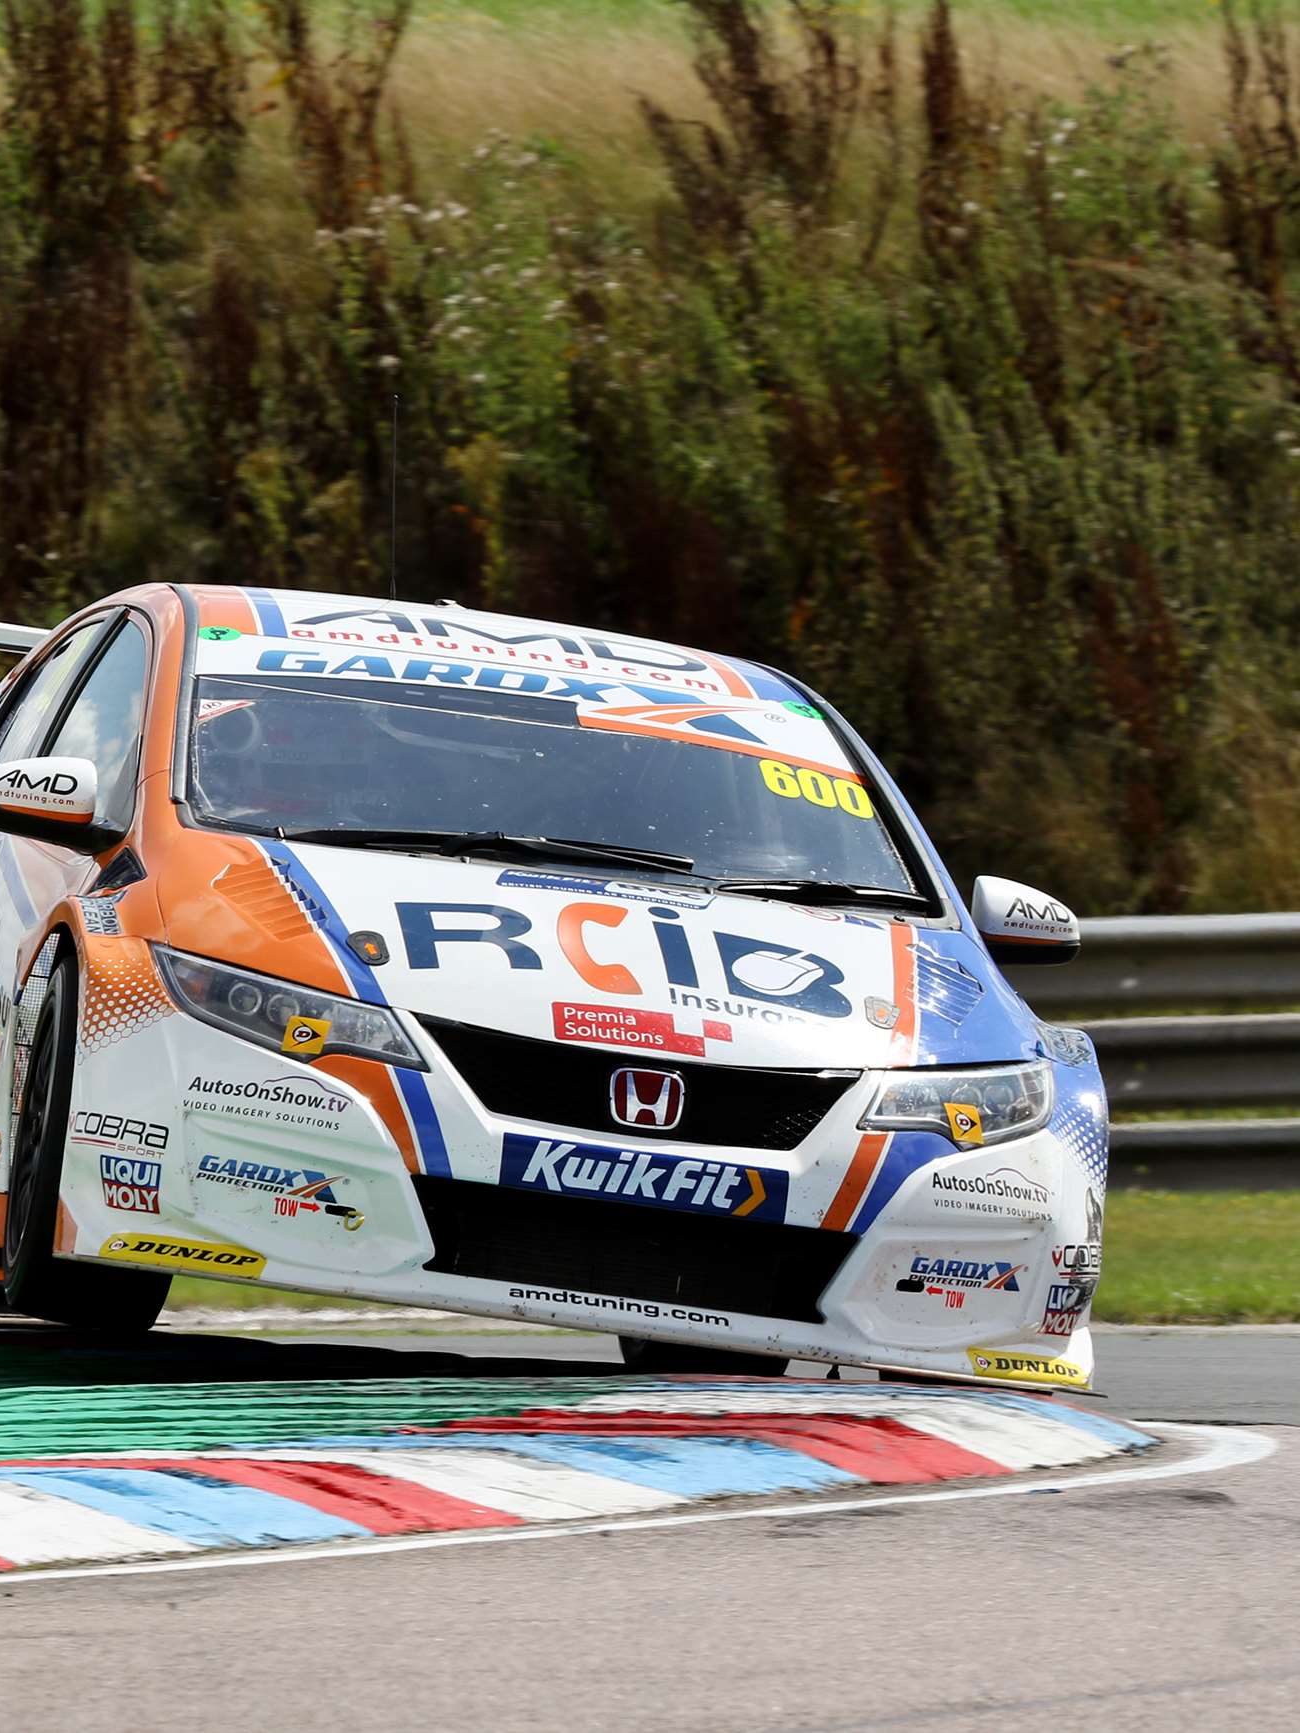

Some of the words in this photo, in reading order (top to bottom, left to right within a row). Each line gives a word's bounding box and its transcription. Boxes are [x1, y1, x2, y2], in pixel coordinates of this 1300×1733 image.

[290, 609, 708, 672] AMD
[291, 628, 719, 692] amdtuning.com
[759, 759, 875, 820] 600
[1005, 897, 1070, 924] AMD
[1003, 921, 1074, 933] amdtuning.com
[563, 1006, 637, 1026] Premia
[564, 1021, 664, 1045] Solutions
[187, 1075, 350, 1114] AutosOnShow.tv
[182, 1099, 217, 1112] VIDEO
[221, 1104, 272, 1121] IMAGERY
[275, 1112, 342, 1132] SOLUTIONS
[116, 1143, 165, 1160] SPORT
[101, 1156, 160, 1187] LIQUI
[195, 1172, 286, 1194] PROTECTION
[104, 1182, 157, 1212] MOLY
[932, 1172, 1048, 1204] AutosOnShow.tv
[274, 1197, 299, 1217] TOW
[933, 1199, 962, 1209] VIDEO
[965, 1201, 1003, 1214] IMAGERY
[1006, 1207, 1053, 1222] SOLUTIONS
[129, 1240, 259, 1267] DUNLOP
[1063, 1244, 1101, 1269] COB
[908, 1274, 982, 1289] PROTECTION
[508, 1285, 731, 1328] amdtuning.com
[944, 1290, 966, 1309] TOW
[995, 1357, 1079, 1379] DUNLOP
